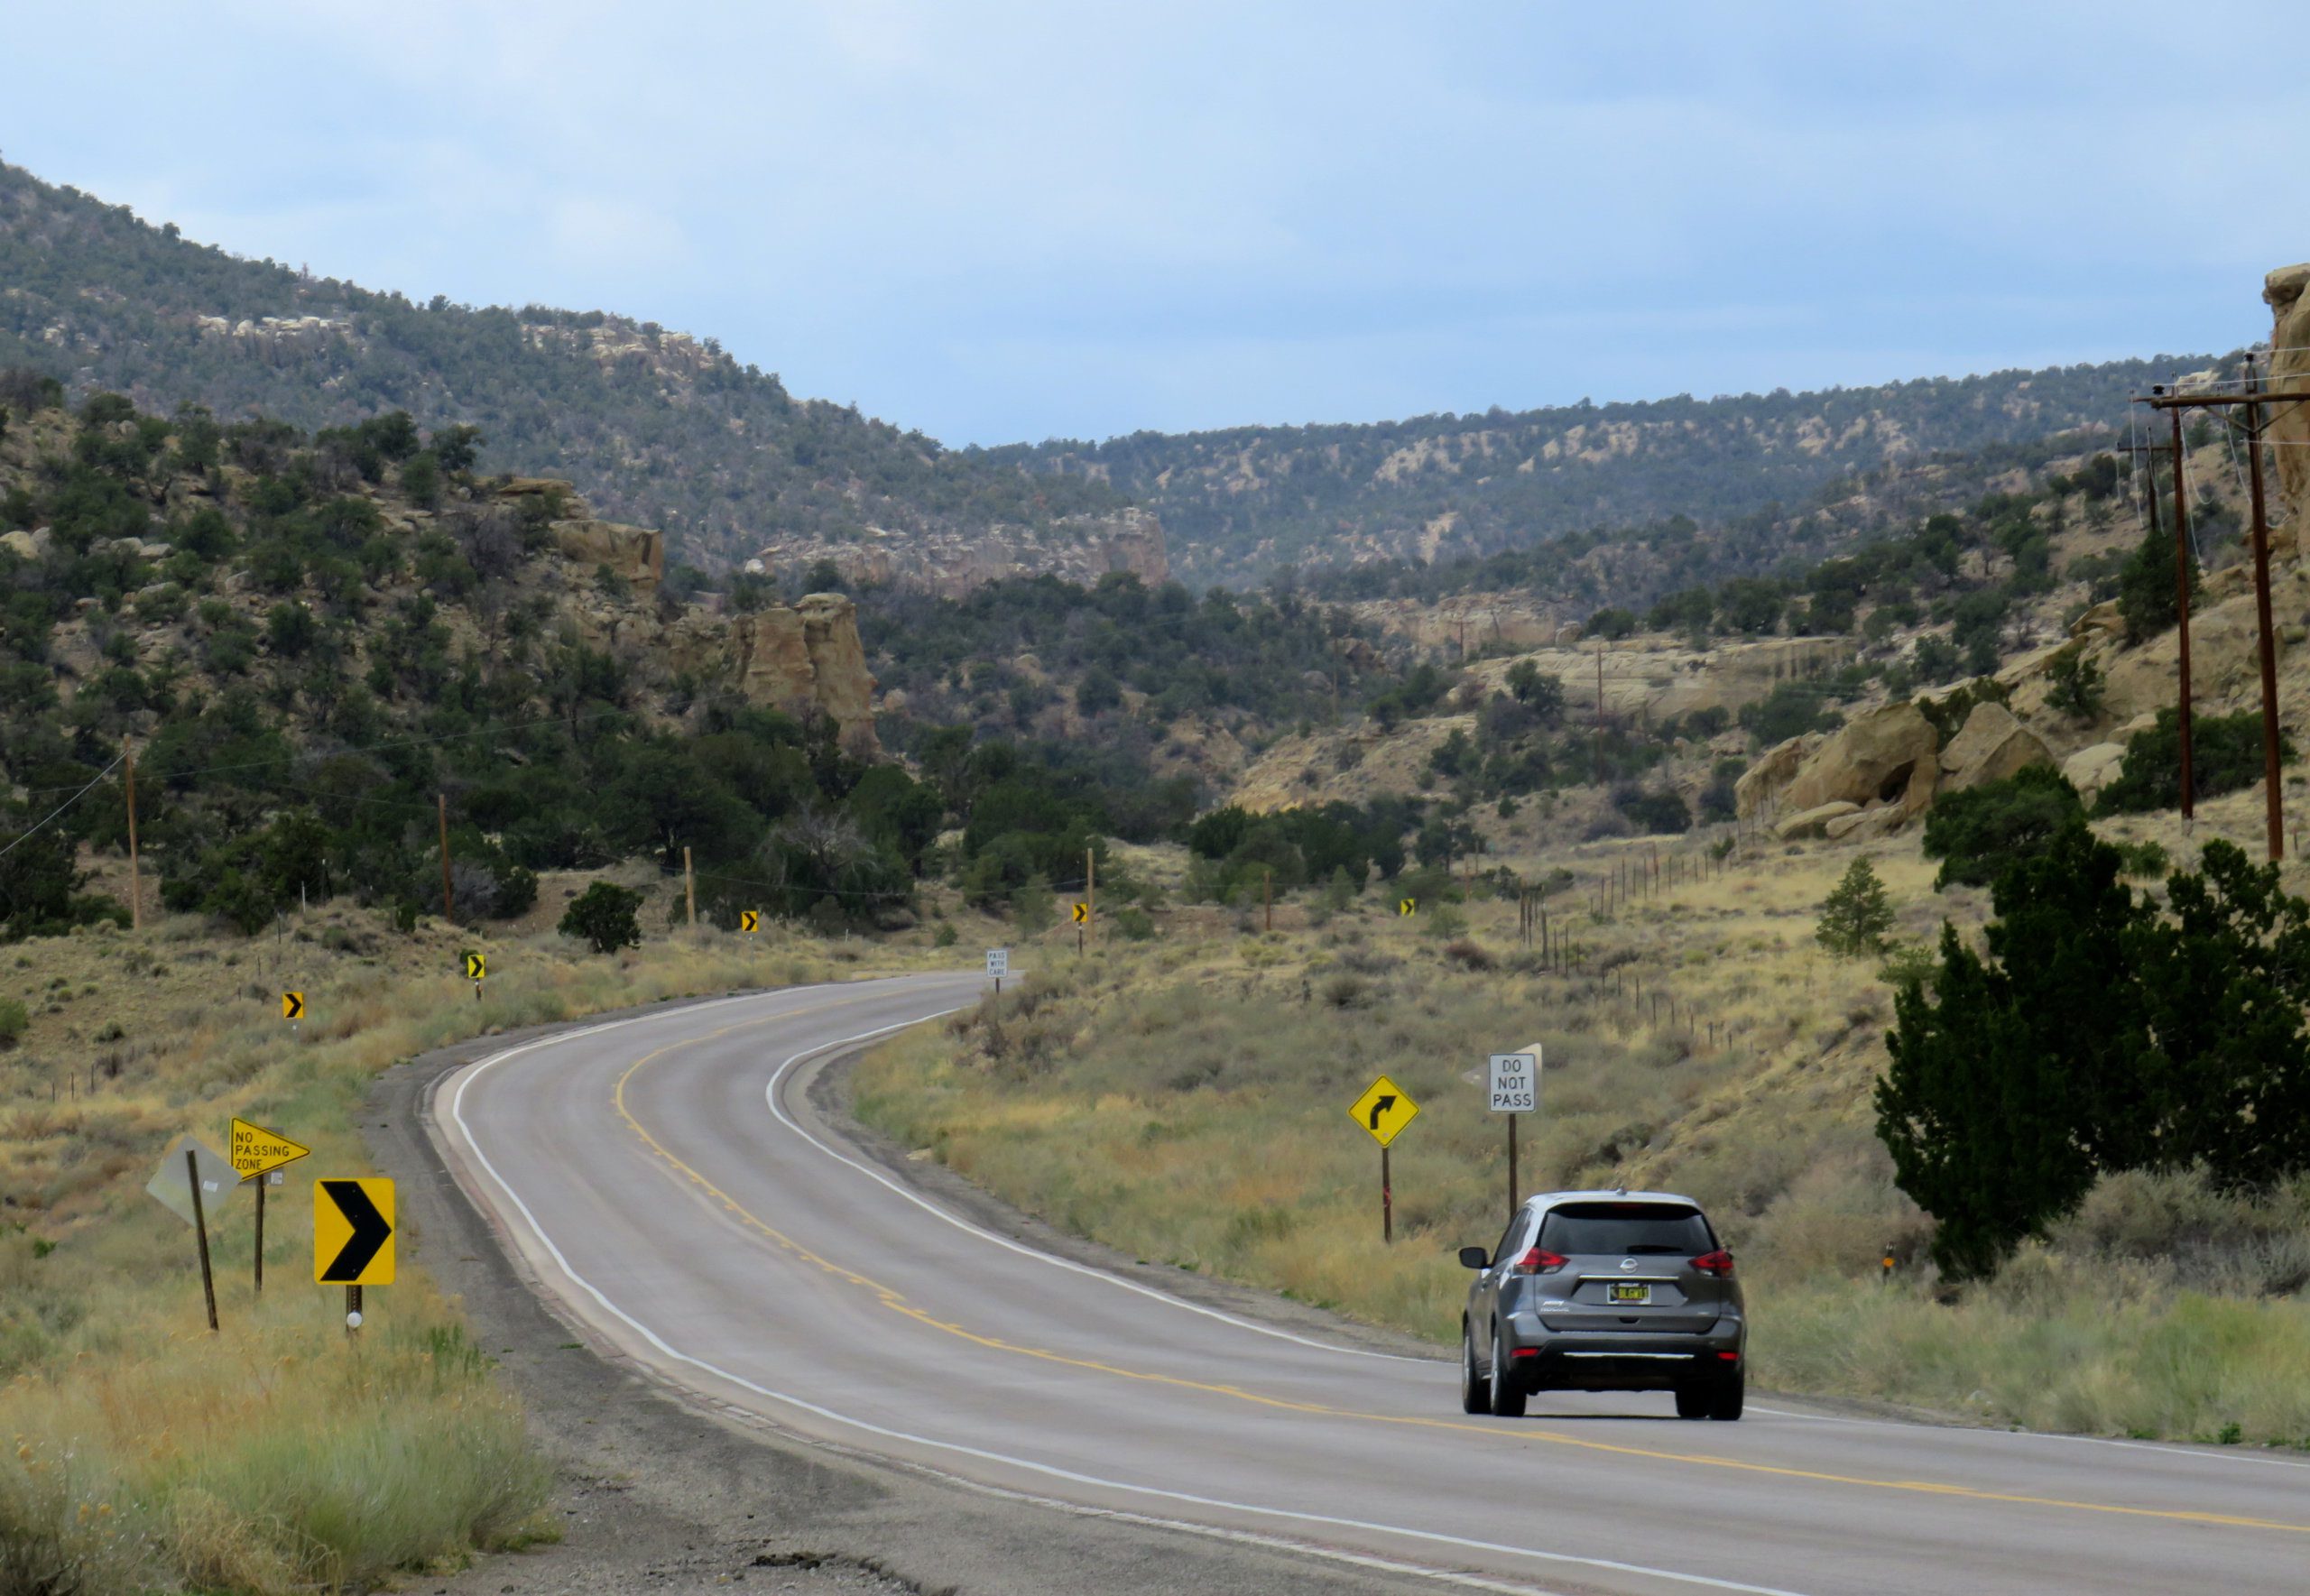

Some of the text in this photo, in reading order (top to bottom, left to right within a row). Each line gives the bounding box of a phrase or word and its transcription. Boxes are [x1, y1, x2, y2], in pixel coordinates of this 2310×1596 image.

[1502, 1059, 1521, 1073] DO
[1498, 1076, 1527, 1090] NOT
[1492, 1093, 1532, 1107] PASS
[236, 1132, 253, 1143] NO
[236, 1145, 290, 1157] PASSING
[236, 1159, 262, 1170] ZONE
